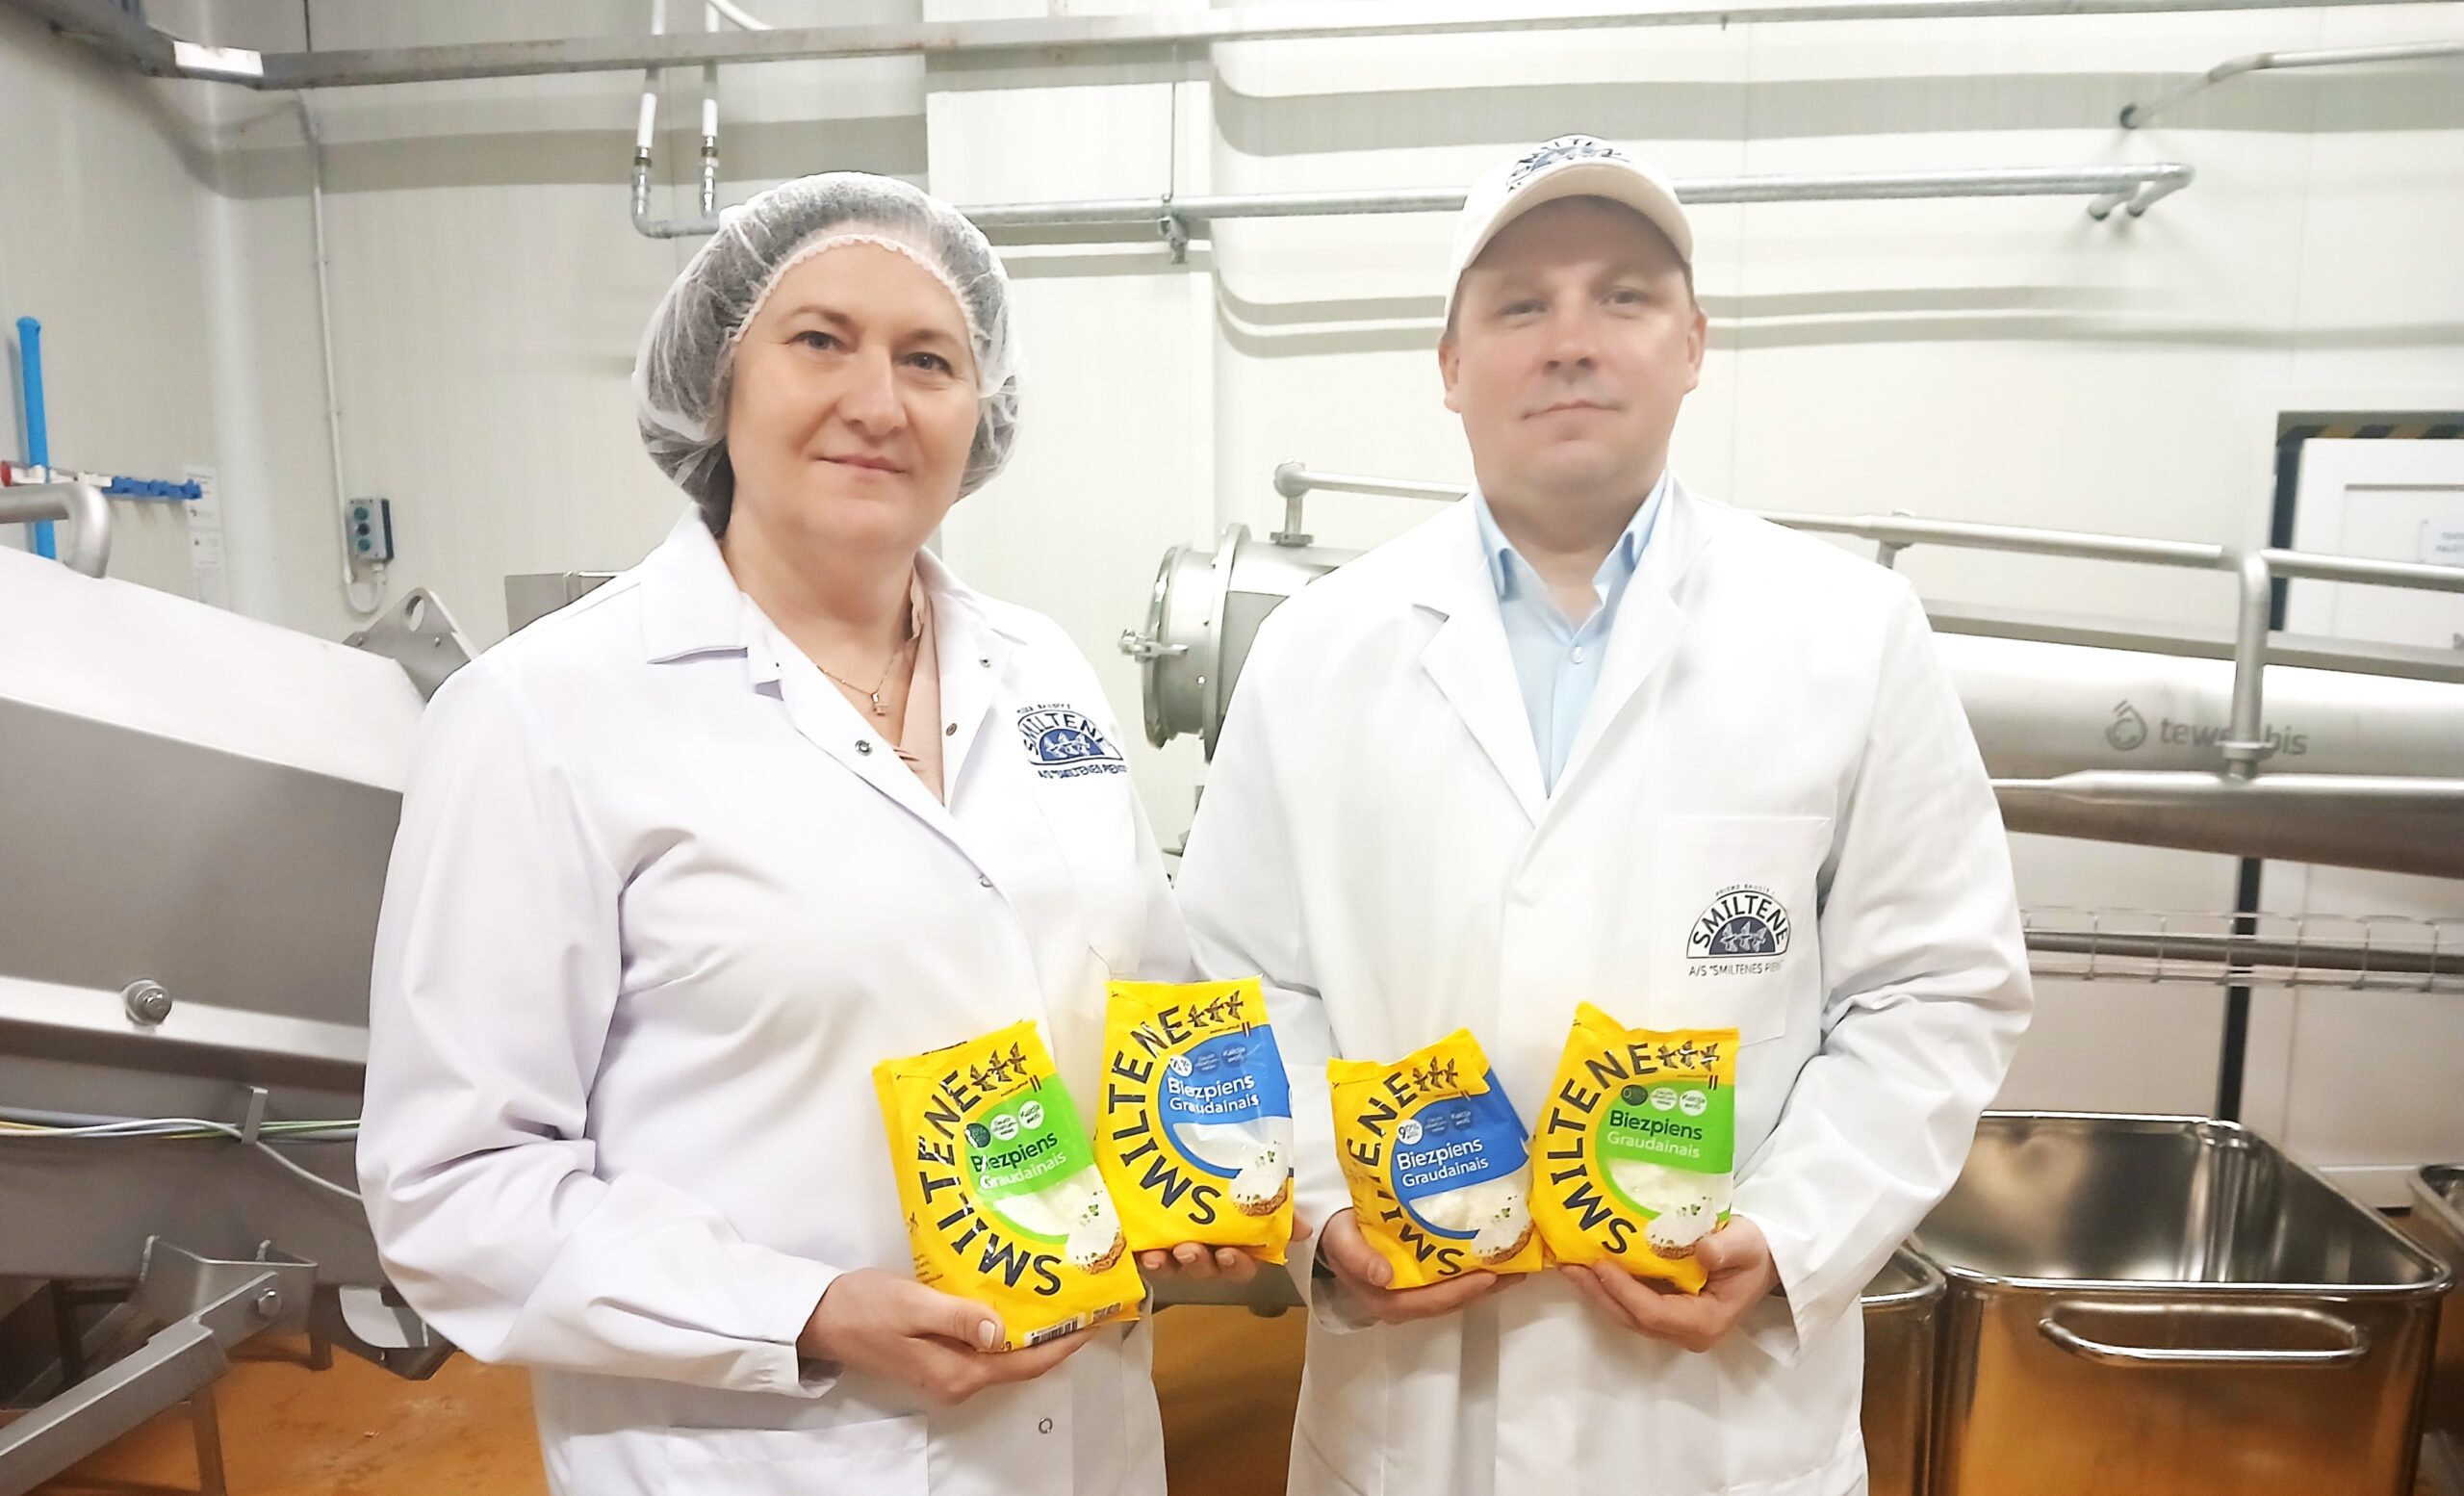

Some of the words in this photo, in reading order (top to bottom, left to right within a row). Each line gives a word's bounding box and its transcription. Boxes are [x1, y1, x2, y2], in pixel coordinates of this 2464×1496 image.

[1693, 894, 1788, 948] SMILTENE
[1168, 1074, 1255, 1102] Biezpiens
[1169, 1094, 1260, 1115] Graudainais
[1108, 1005, 1220, 1225] SMILTENE
[1609, 1109, 1703, 1140] Biezpiens
[1397, 1138, 1483, 1171] Biezpiens
[1547, 1043, 1657, 1254] SMILTENE
[1607, 1130, 1701, 1158] Graudainais
[918, 1070, 1062, 1296] SMILTENE
[979, 1151, 1066, 1190] Graudainais
[1348, 1071, 1464, 1276] SMIENE
[1402, 1156, 1489, 1187] Graudainais
